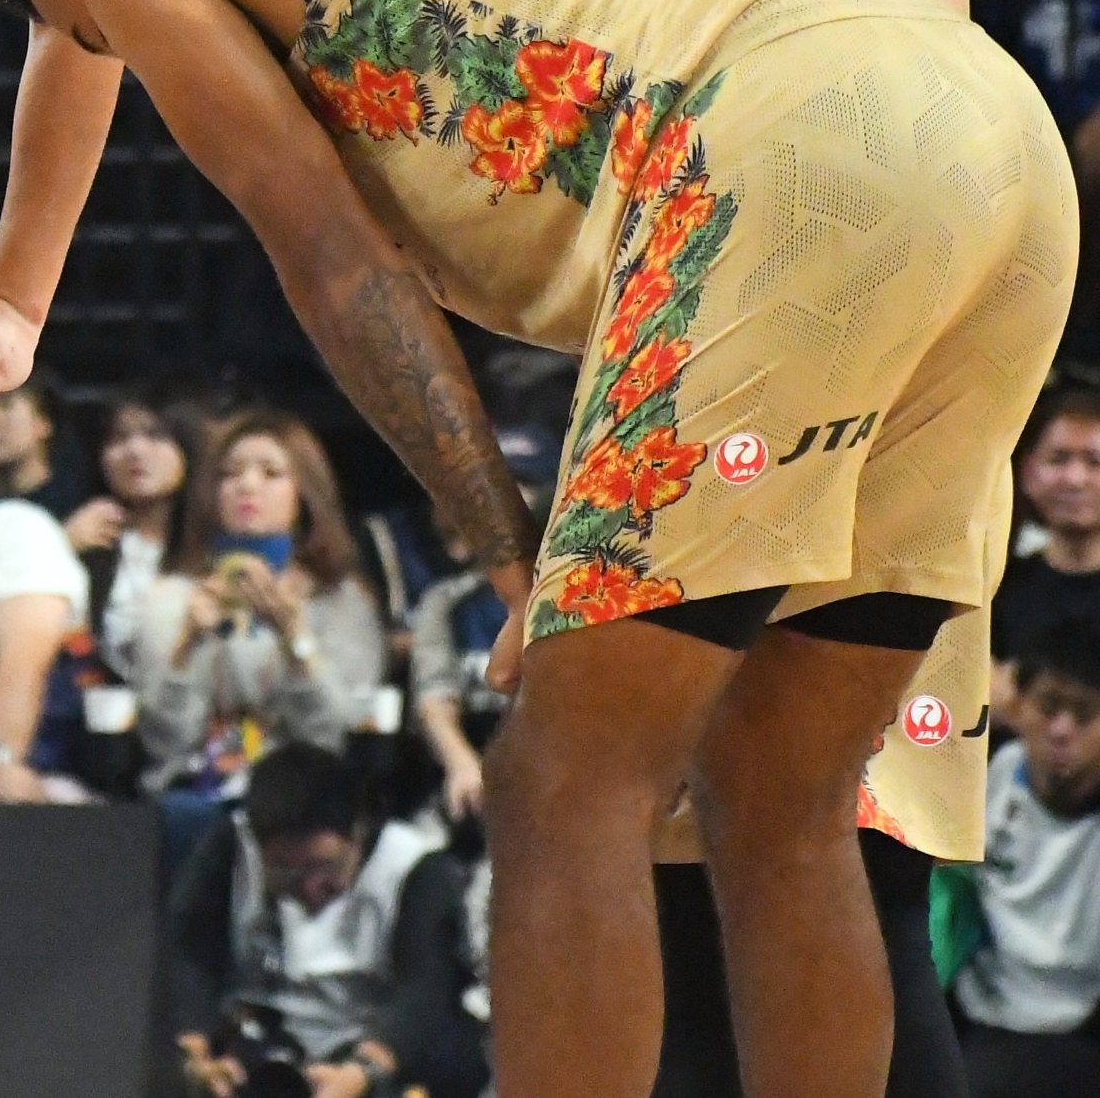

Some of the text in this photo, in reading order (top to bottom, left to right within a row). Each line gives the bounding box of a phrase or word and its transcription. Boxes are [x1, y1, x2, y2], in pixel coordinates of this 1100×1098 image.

[729, 410, 879, 479] JAL JTA
[914, 730, 942, 740] JAL
